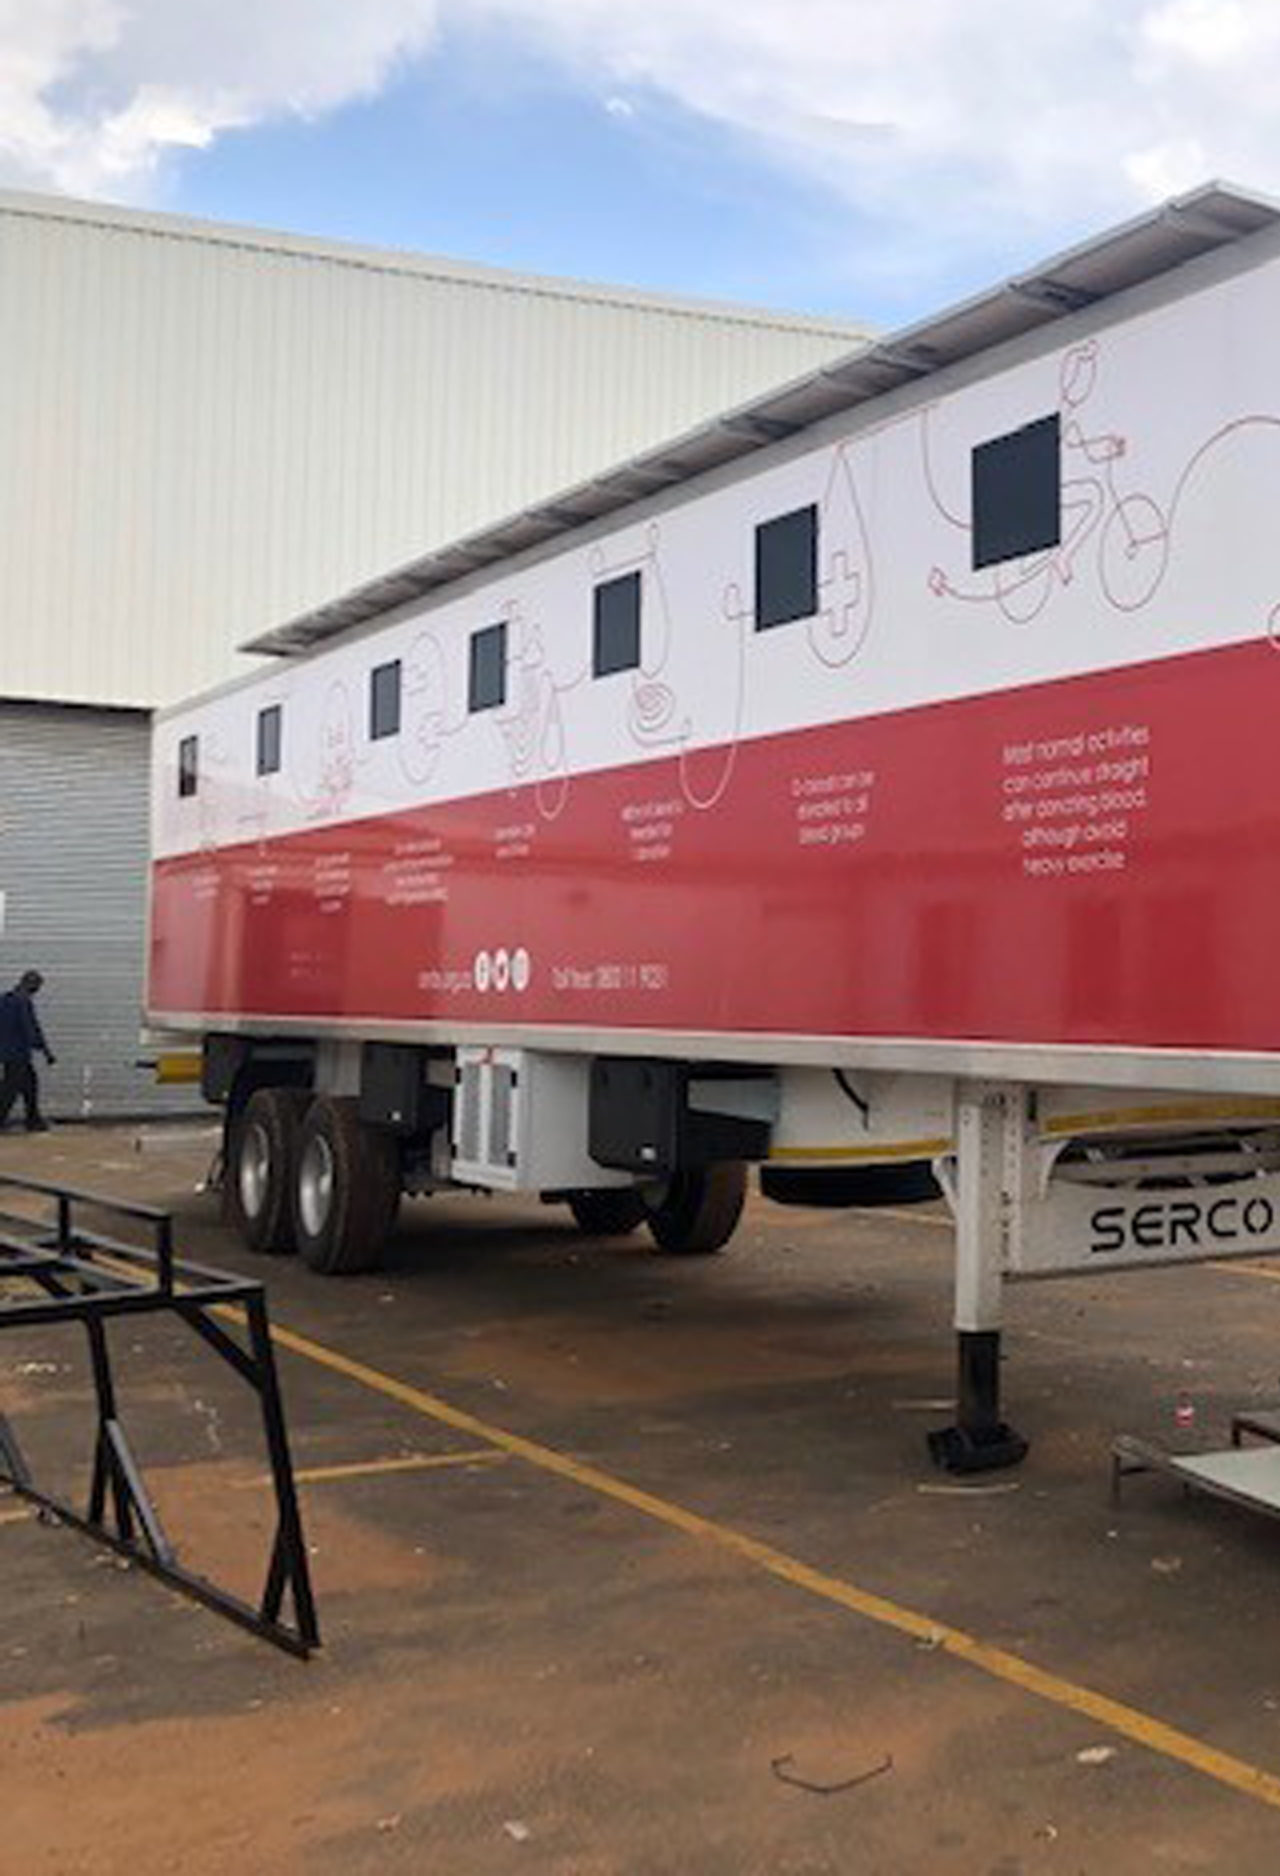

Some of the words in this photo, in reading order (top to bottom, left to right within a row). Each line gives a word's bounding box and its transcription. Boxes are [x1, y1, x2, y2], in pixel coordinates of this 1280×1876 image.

[1036, 734, 1085, 759] normal
[1088, 726, 1149, 751] activities
[1003, 776, 1030, 793] can
[1031, 767, 1091, 790] continue
[1096, 756, 1149, 783] straight
[1035, 795, 1099, 817] donating
[1023, 825, 1081, 848] although
[1084, 820, 1127, 842] avoid
[1090, 1198, 1274, 1253] SERCO
